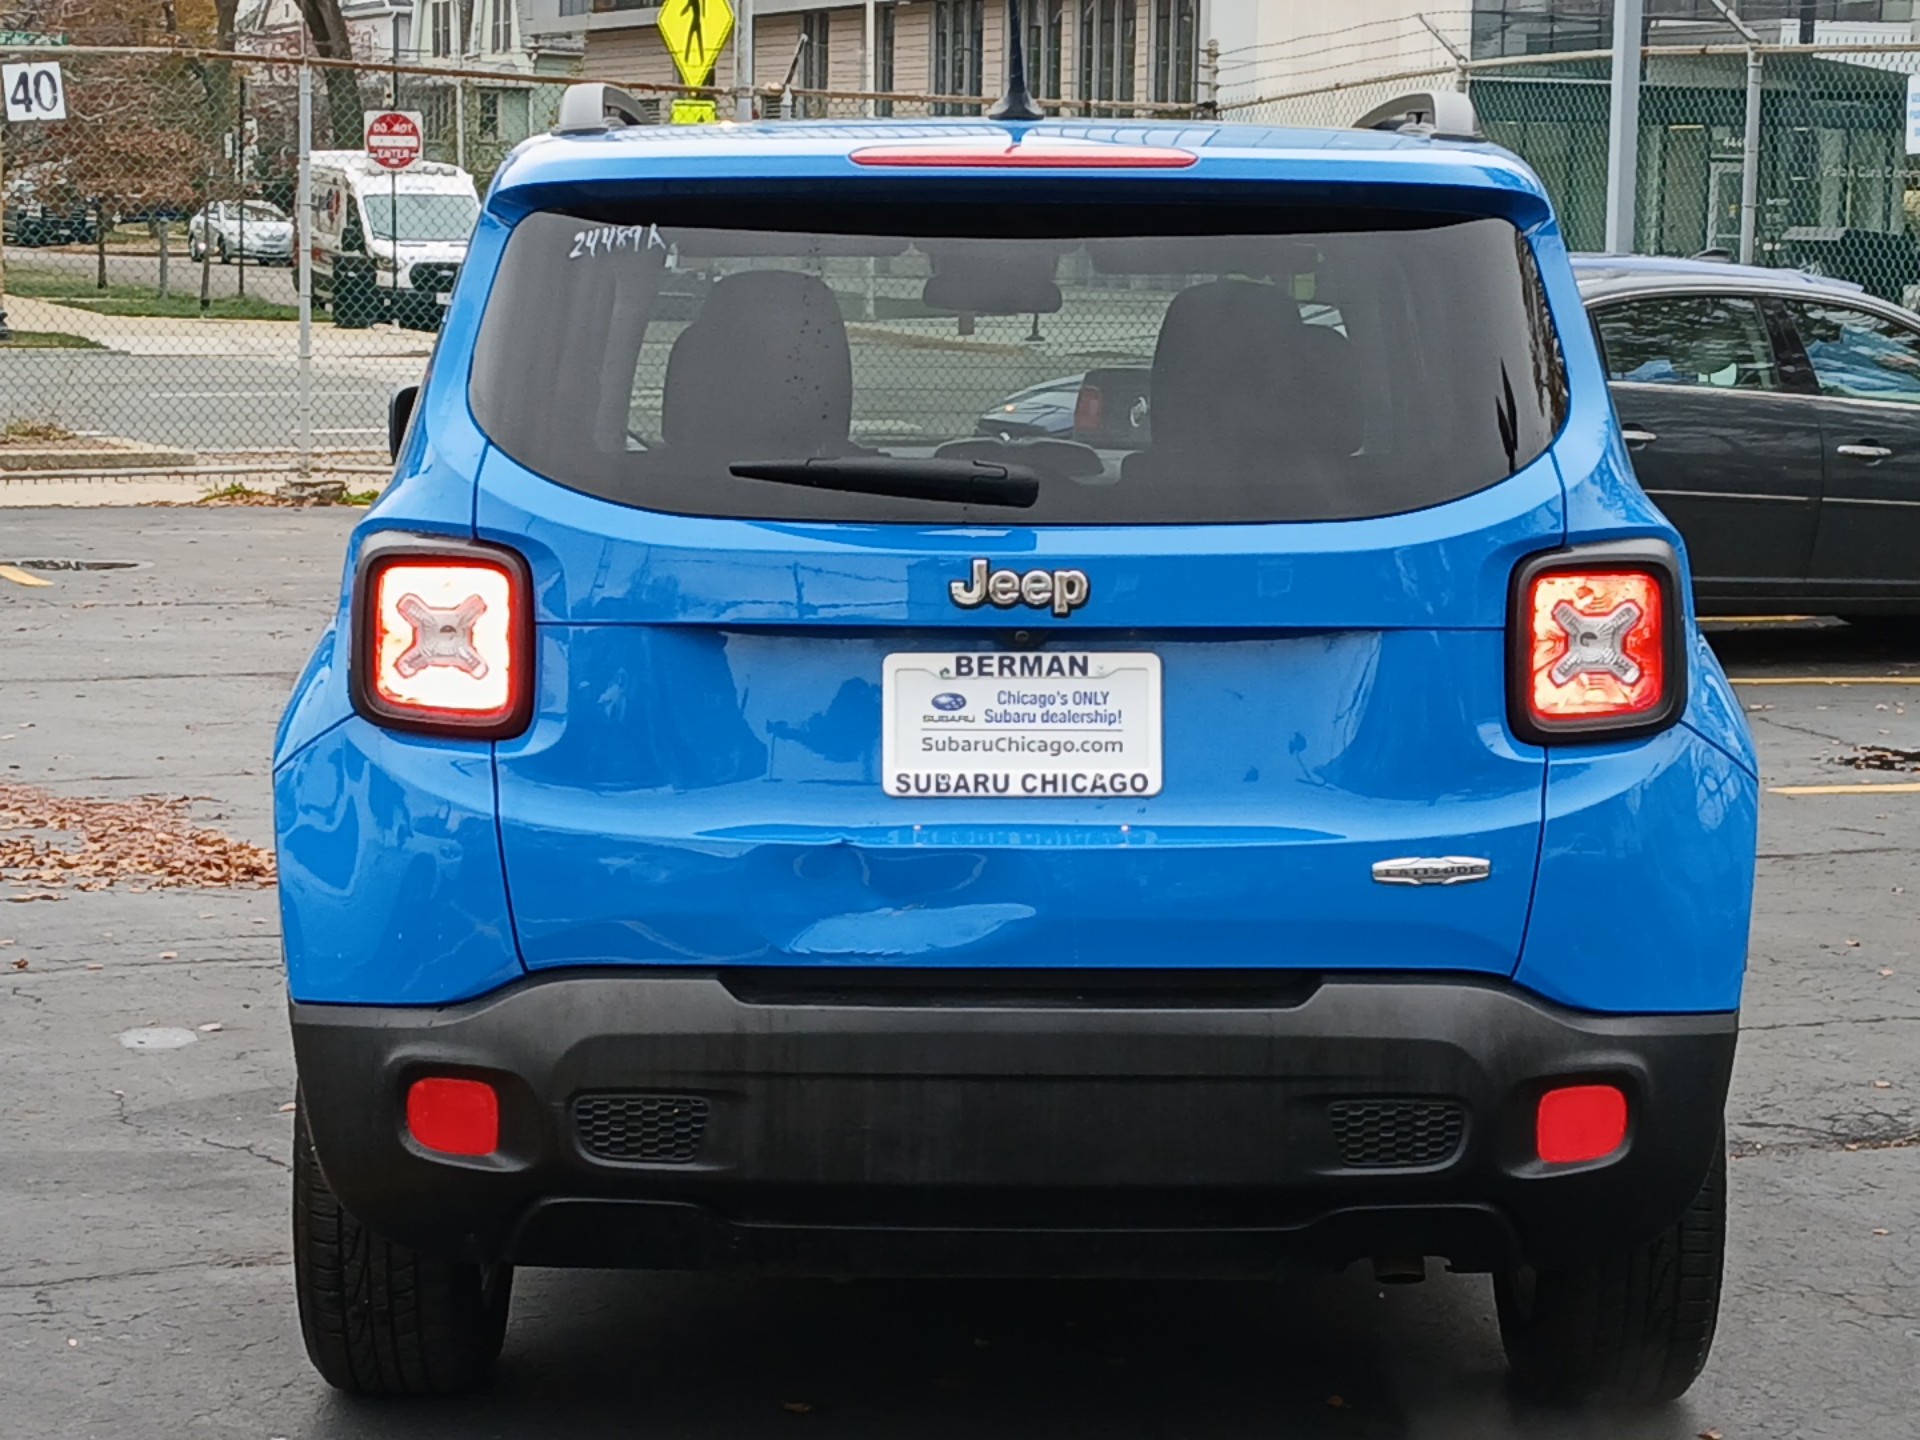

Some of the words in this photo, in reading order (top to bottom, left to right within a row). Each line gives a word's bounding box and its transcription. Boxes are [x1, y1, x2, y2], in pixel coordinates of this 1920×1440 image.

[11, 69, 58, 113] 40
[950, 558, 1089, 615] Jeep
[955, 655, 1089, 677] BERMAN
[997, 690, 1068, 708] Chicago's
[1072, 691, 1110, 706] ONLY
[923, 715, 975, 723] SUBARU
[984, 709, 1037, 724] Subaru
[1041, 709, 1123, 726] dealership!
[921, 736, 1124, 756] SubaruChicago.com
[895, 773, 1010, 793] SUBARU
[1021, 773, 1149, 793] CHICAGO
